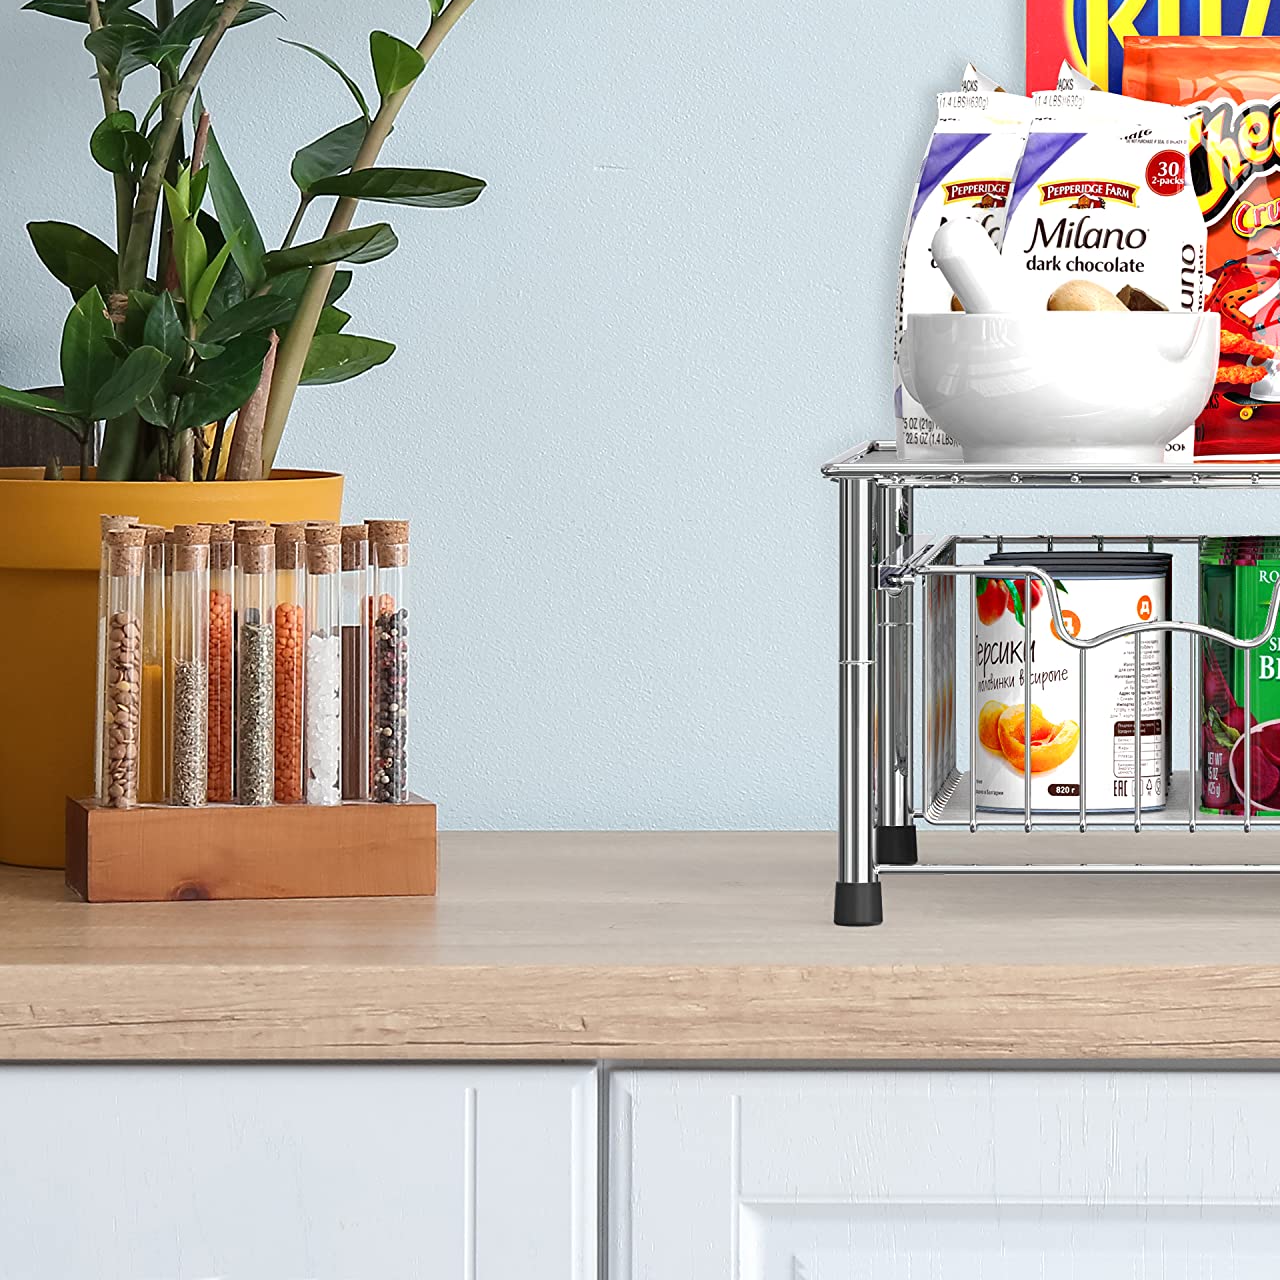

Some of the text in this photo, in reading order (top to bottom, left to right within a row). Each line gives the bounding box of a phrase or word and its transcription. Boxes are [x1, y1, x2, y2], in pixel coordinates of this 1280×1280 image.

[961, 79, 978, 93] ACKS
[1057, 78, 1074, 91] ACKS
[1157, 161, 1180, 177] 30
[1151, 176, 1185, 187] 2-packs
[951, 183, 1007, 198] PEPPERIDGE
[1047, 183, 1130, 199] PEPPERIDGE FARM
[1023, 215, 1148, 253] Milano
[1025, 254, 1145, 273] dark chocolate
[1055, 786, 1070, 794] 820
